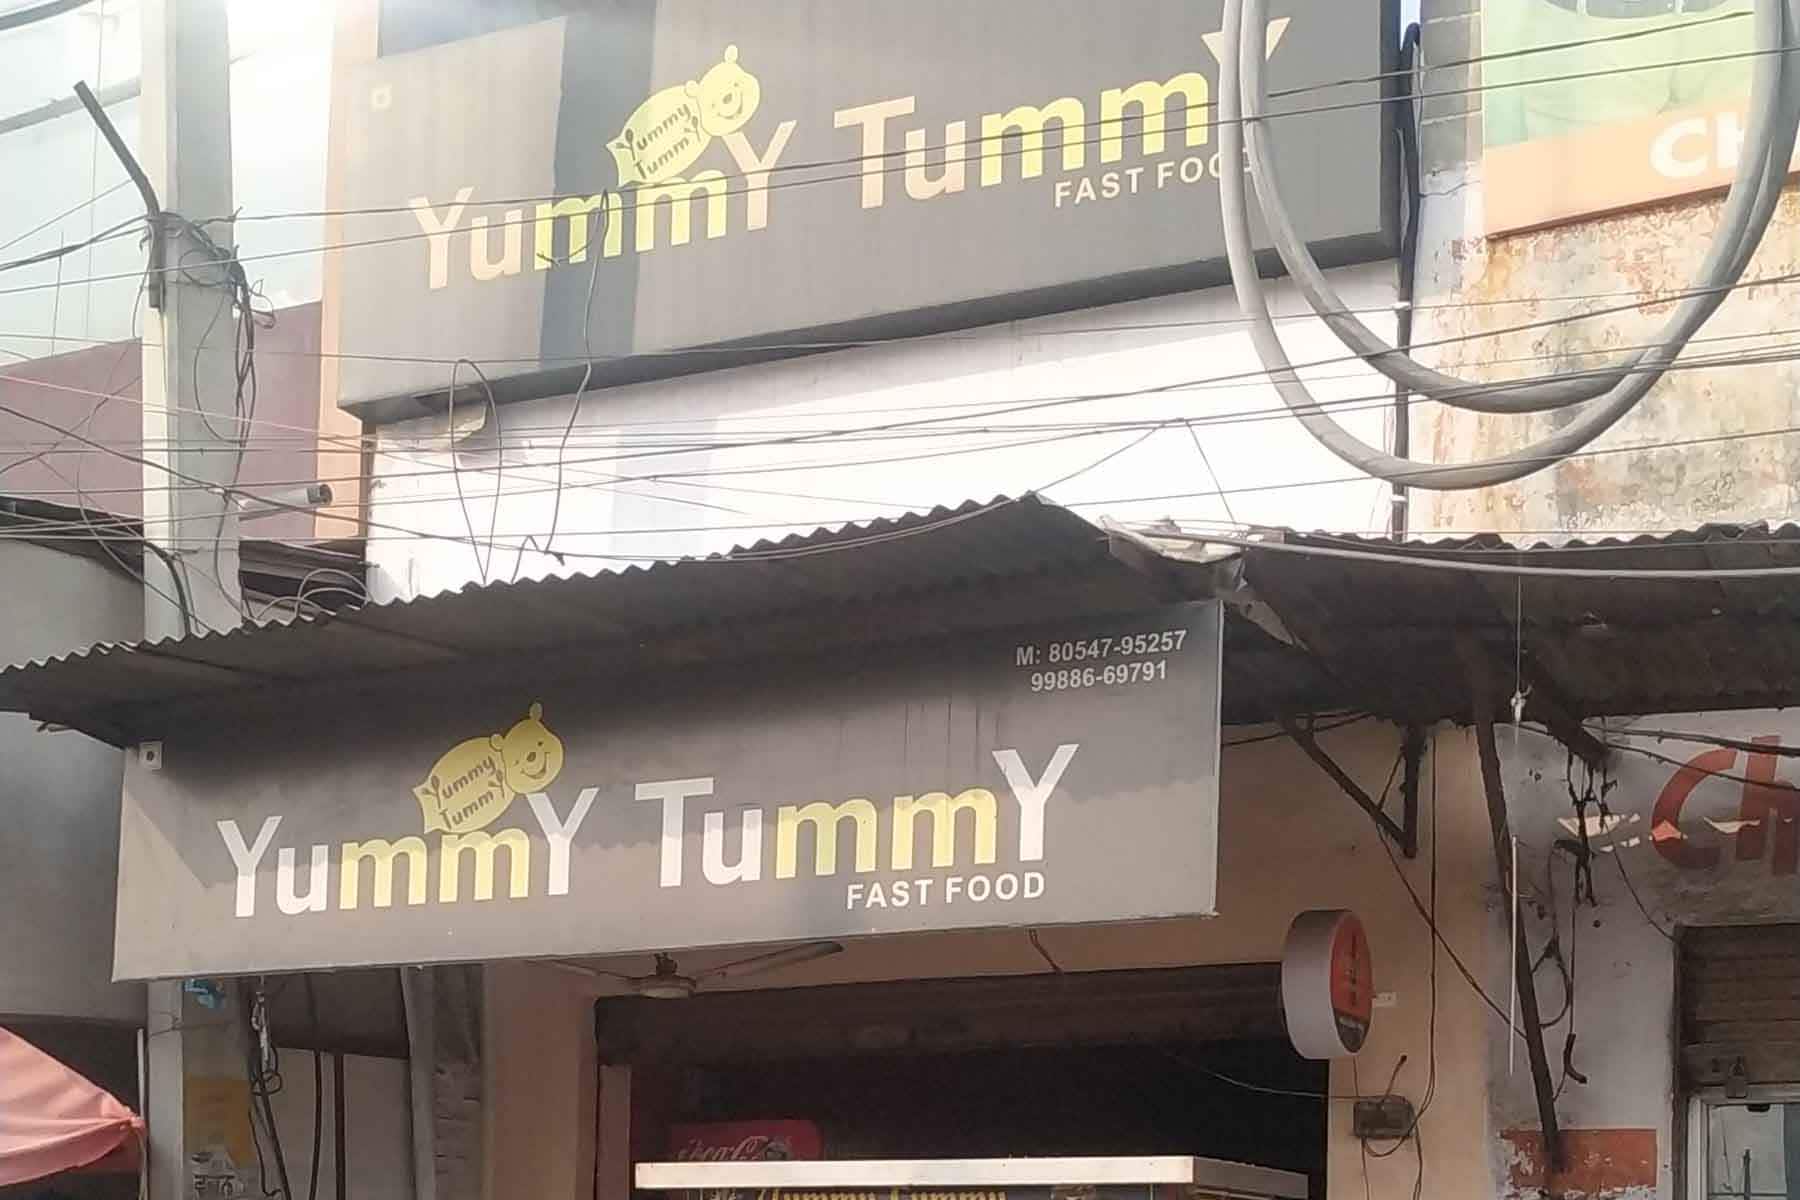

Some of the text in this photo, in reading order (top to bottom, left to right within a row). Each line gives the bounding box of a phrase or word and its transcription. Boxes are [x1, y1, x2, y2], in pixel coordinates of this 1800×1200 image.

[616, 104, 691, 160] Yummy
[1055, 167, 1145, 208] FAST
[1049, 630, 1187, 663] 80547-95257
[1032, 660, 1167, 692] 99886-69791
[422, 755, 497, 808] Yummy
[847, 871, 1046, 910] FAST FOOD
